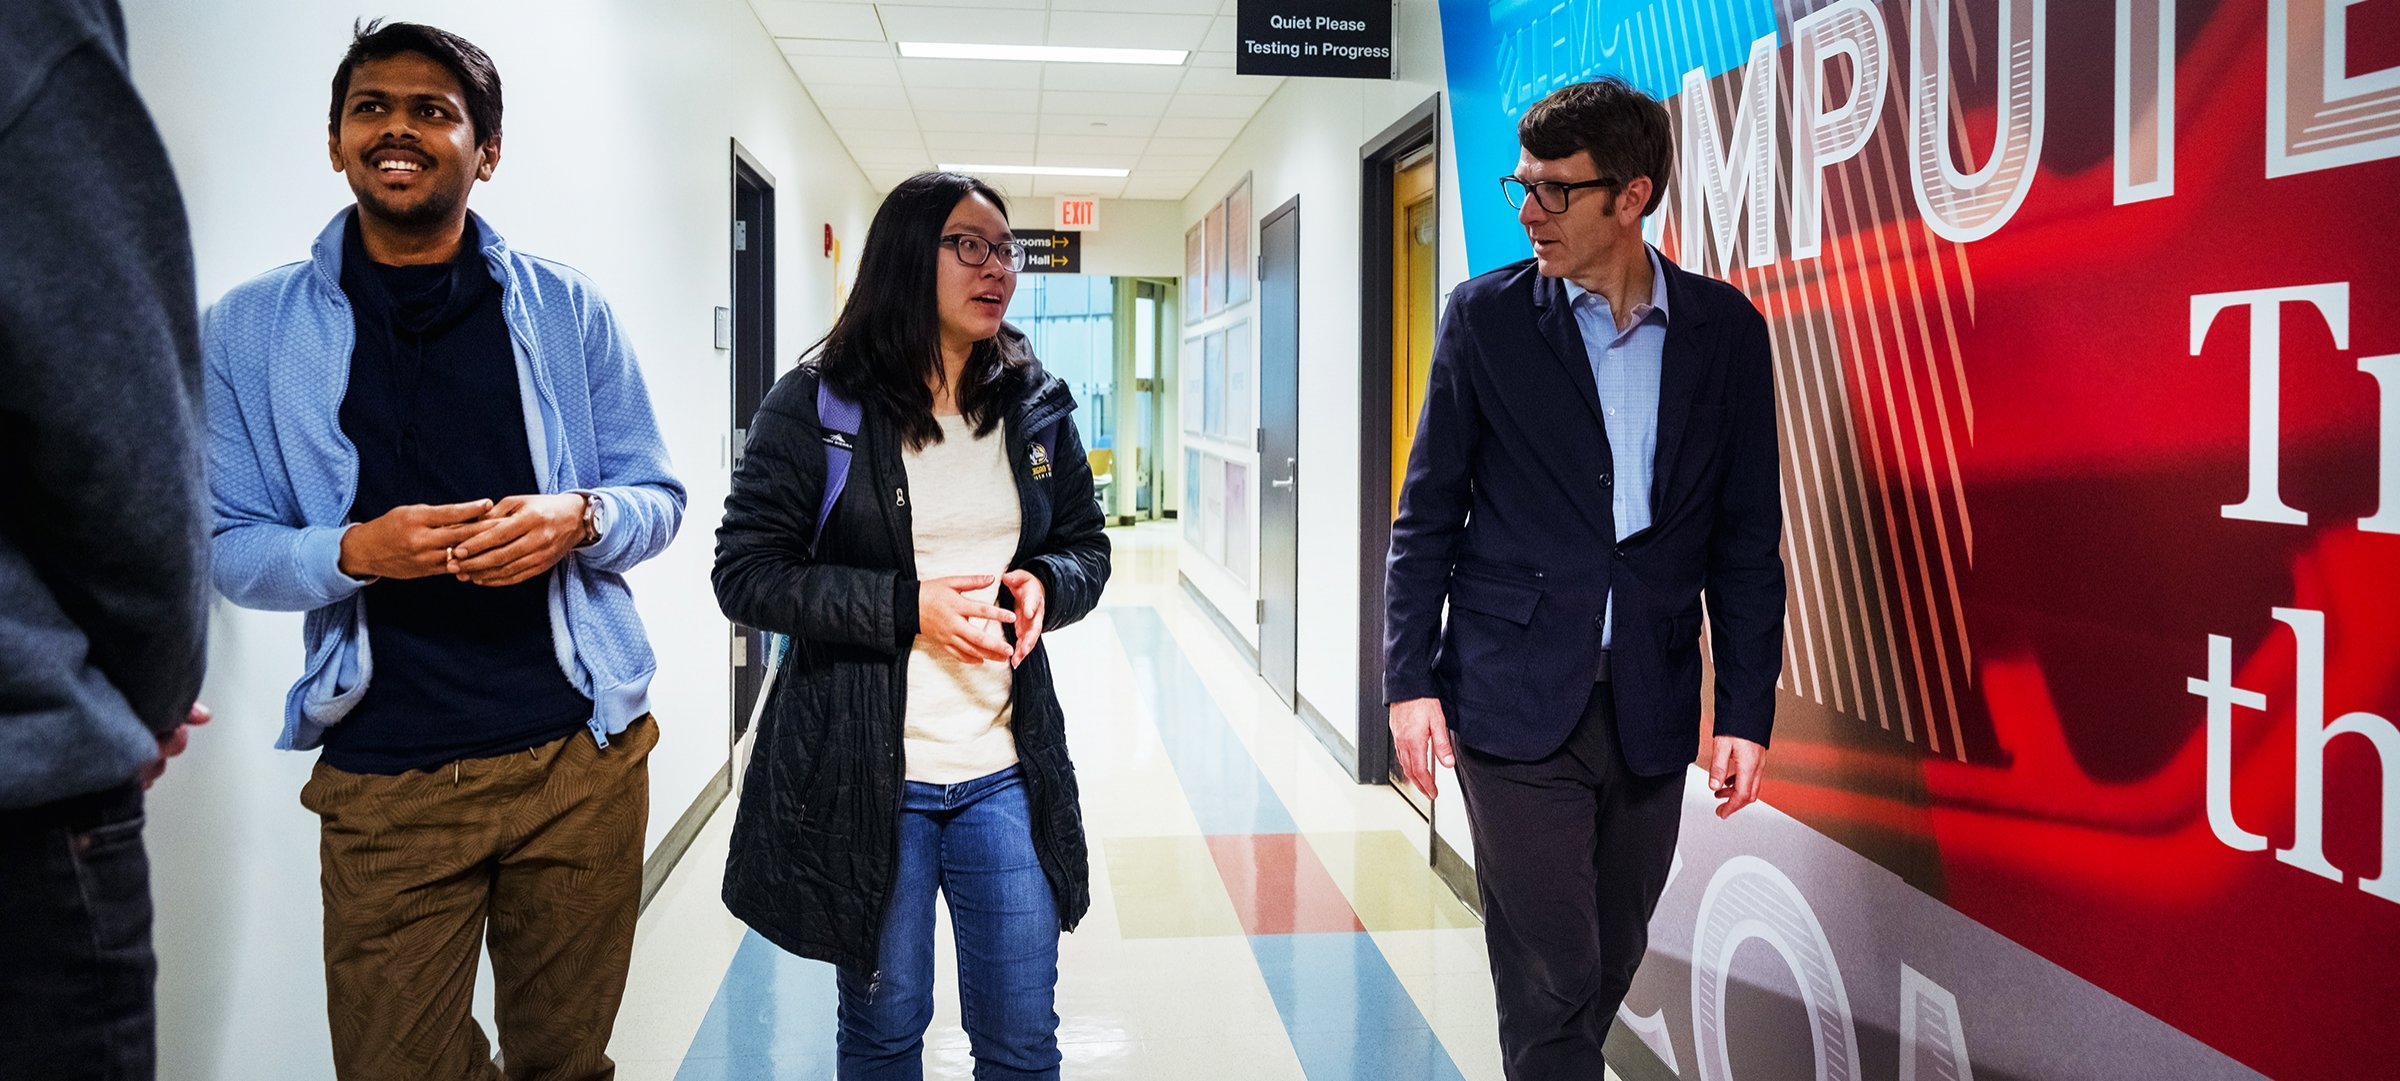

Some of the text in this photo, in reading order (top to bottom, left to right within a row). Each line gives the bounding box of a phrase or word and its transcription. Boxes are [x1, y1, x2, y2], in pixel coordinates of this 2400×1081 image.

[1270, 15, 1366, 31] Quiet Please
[1245, 40, 1390, 60] Testing in Progress
[1063, 201, 1093, 225] EXIT
[1028, 255, 1050, 265] Hall
